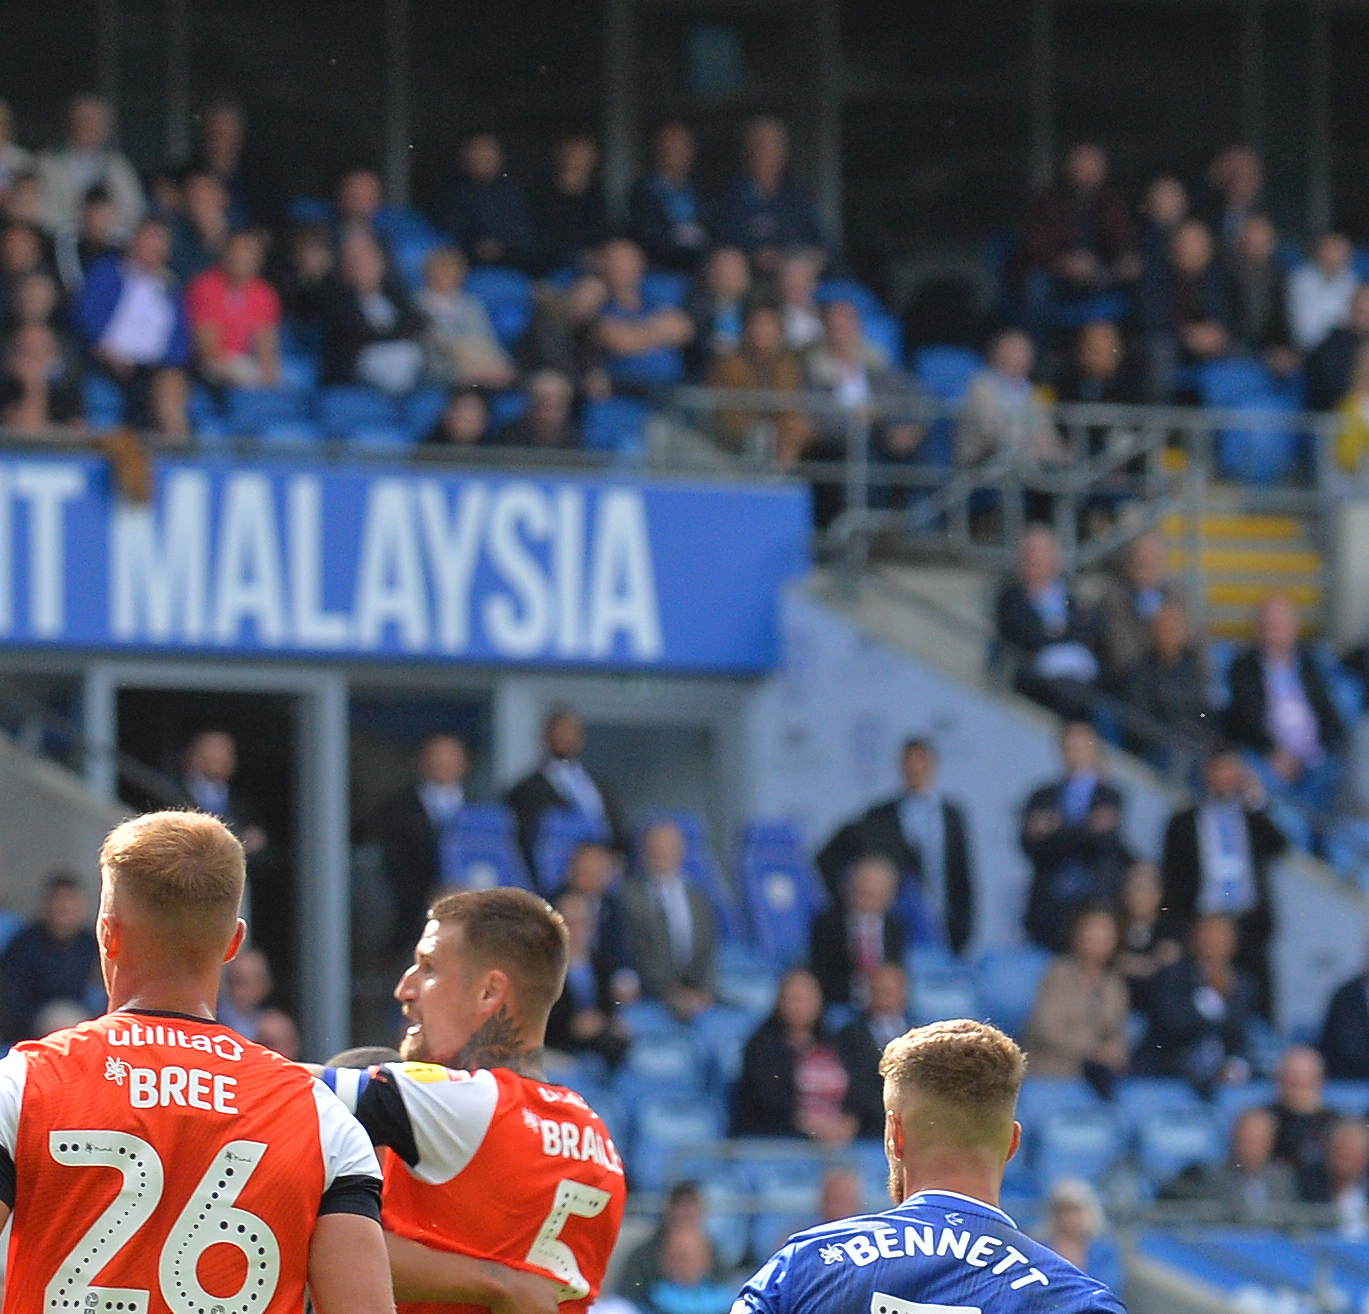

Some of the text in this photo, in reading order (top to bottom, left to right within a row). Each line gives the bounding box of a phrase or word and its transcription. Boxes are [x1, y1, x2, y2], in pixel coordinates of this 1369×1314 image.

[110, 468, 663, 661] MALAYSIA
[107, 1022, 212, 1055] utilita
[129, 1065, 239, 1115] BREE
[524, 1178, 613, 1304] 5
[841, 1225, 1049, 1291] BENNETT
